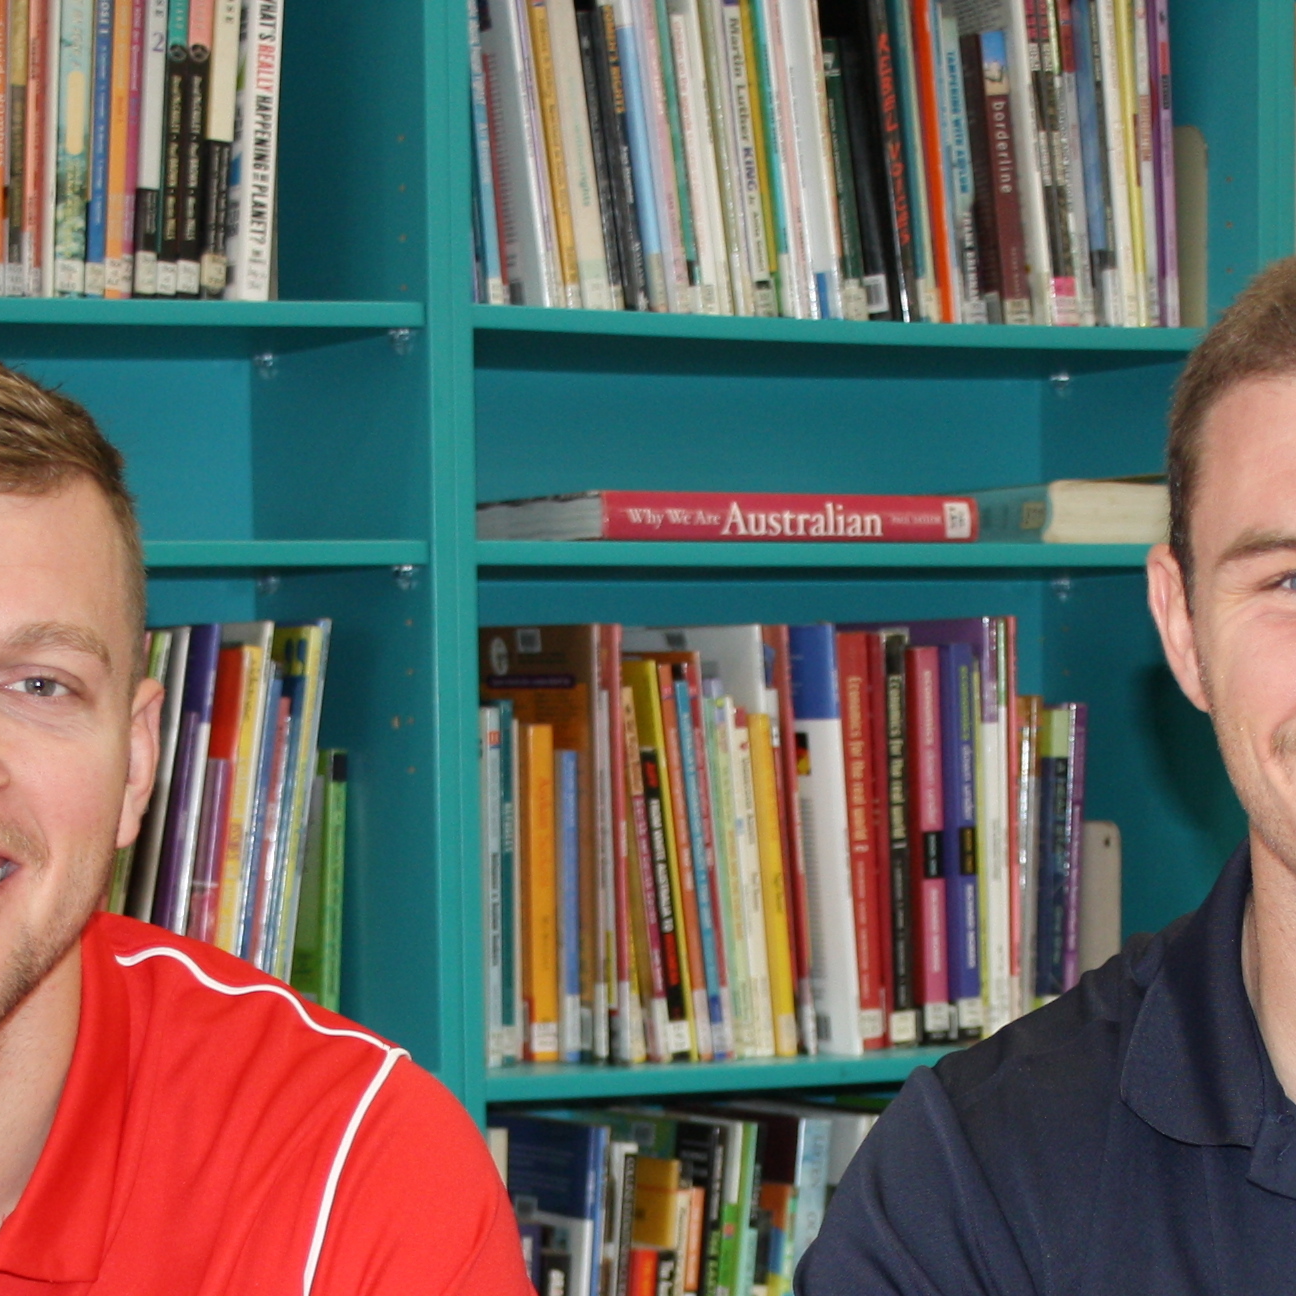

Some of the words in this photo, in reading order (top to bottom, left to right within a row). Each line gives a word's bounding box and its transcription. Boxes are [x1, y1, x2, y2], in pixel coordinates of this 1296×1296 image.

[255, 43, 276, 91] REALLY
[727, 16, 745, 78] Martin
[250, 94, 274, 169] HAPPENING
[735, 83, 752, 142] Luther
[742, 145, 758, 192] KING
[987, 99, 1016, 195] borderline
[247, 182, 269, 244] PLANET?
[628, 508, 663, 531] Why
[666, 509, 691, 528] We
[695, 509, 721, 528] Are
[721, 502, 883, 537] Australian
[848, 675, 864, 737] Economics
[887, 674, 904, 736] Economics
[923, 669, 935, 746] economics
[960, 664, 972, 741] economics
[850, 740, 864, 757] for
[851, 760, 865, 779] the
[889, 738, 904, 756] for
[889, 758, 905, 778] the
[851, 781, 866, 805] real
[890, 779, 906, 804] real
[852, 807, 868, 841] world
[890, 805, 907, 840] world
